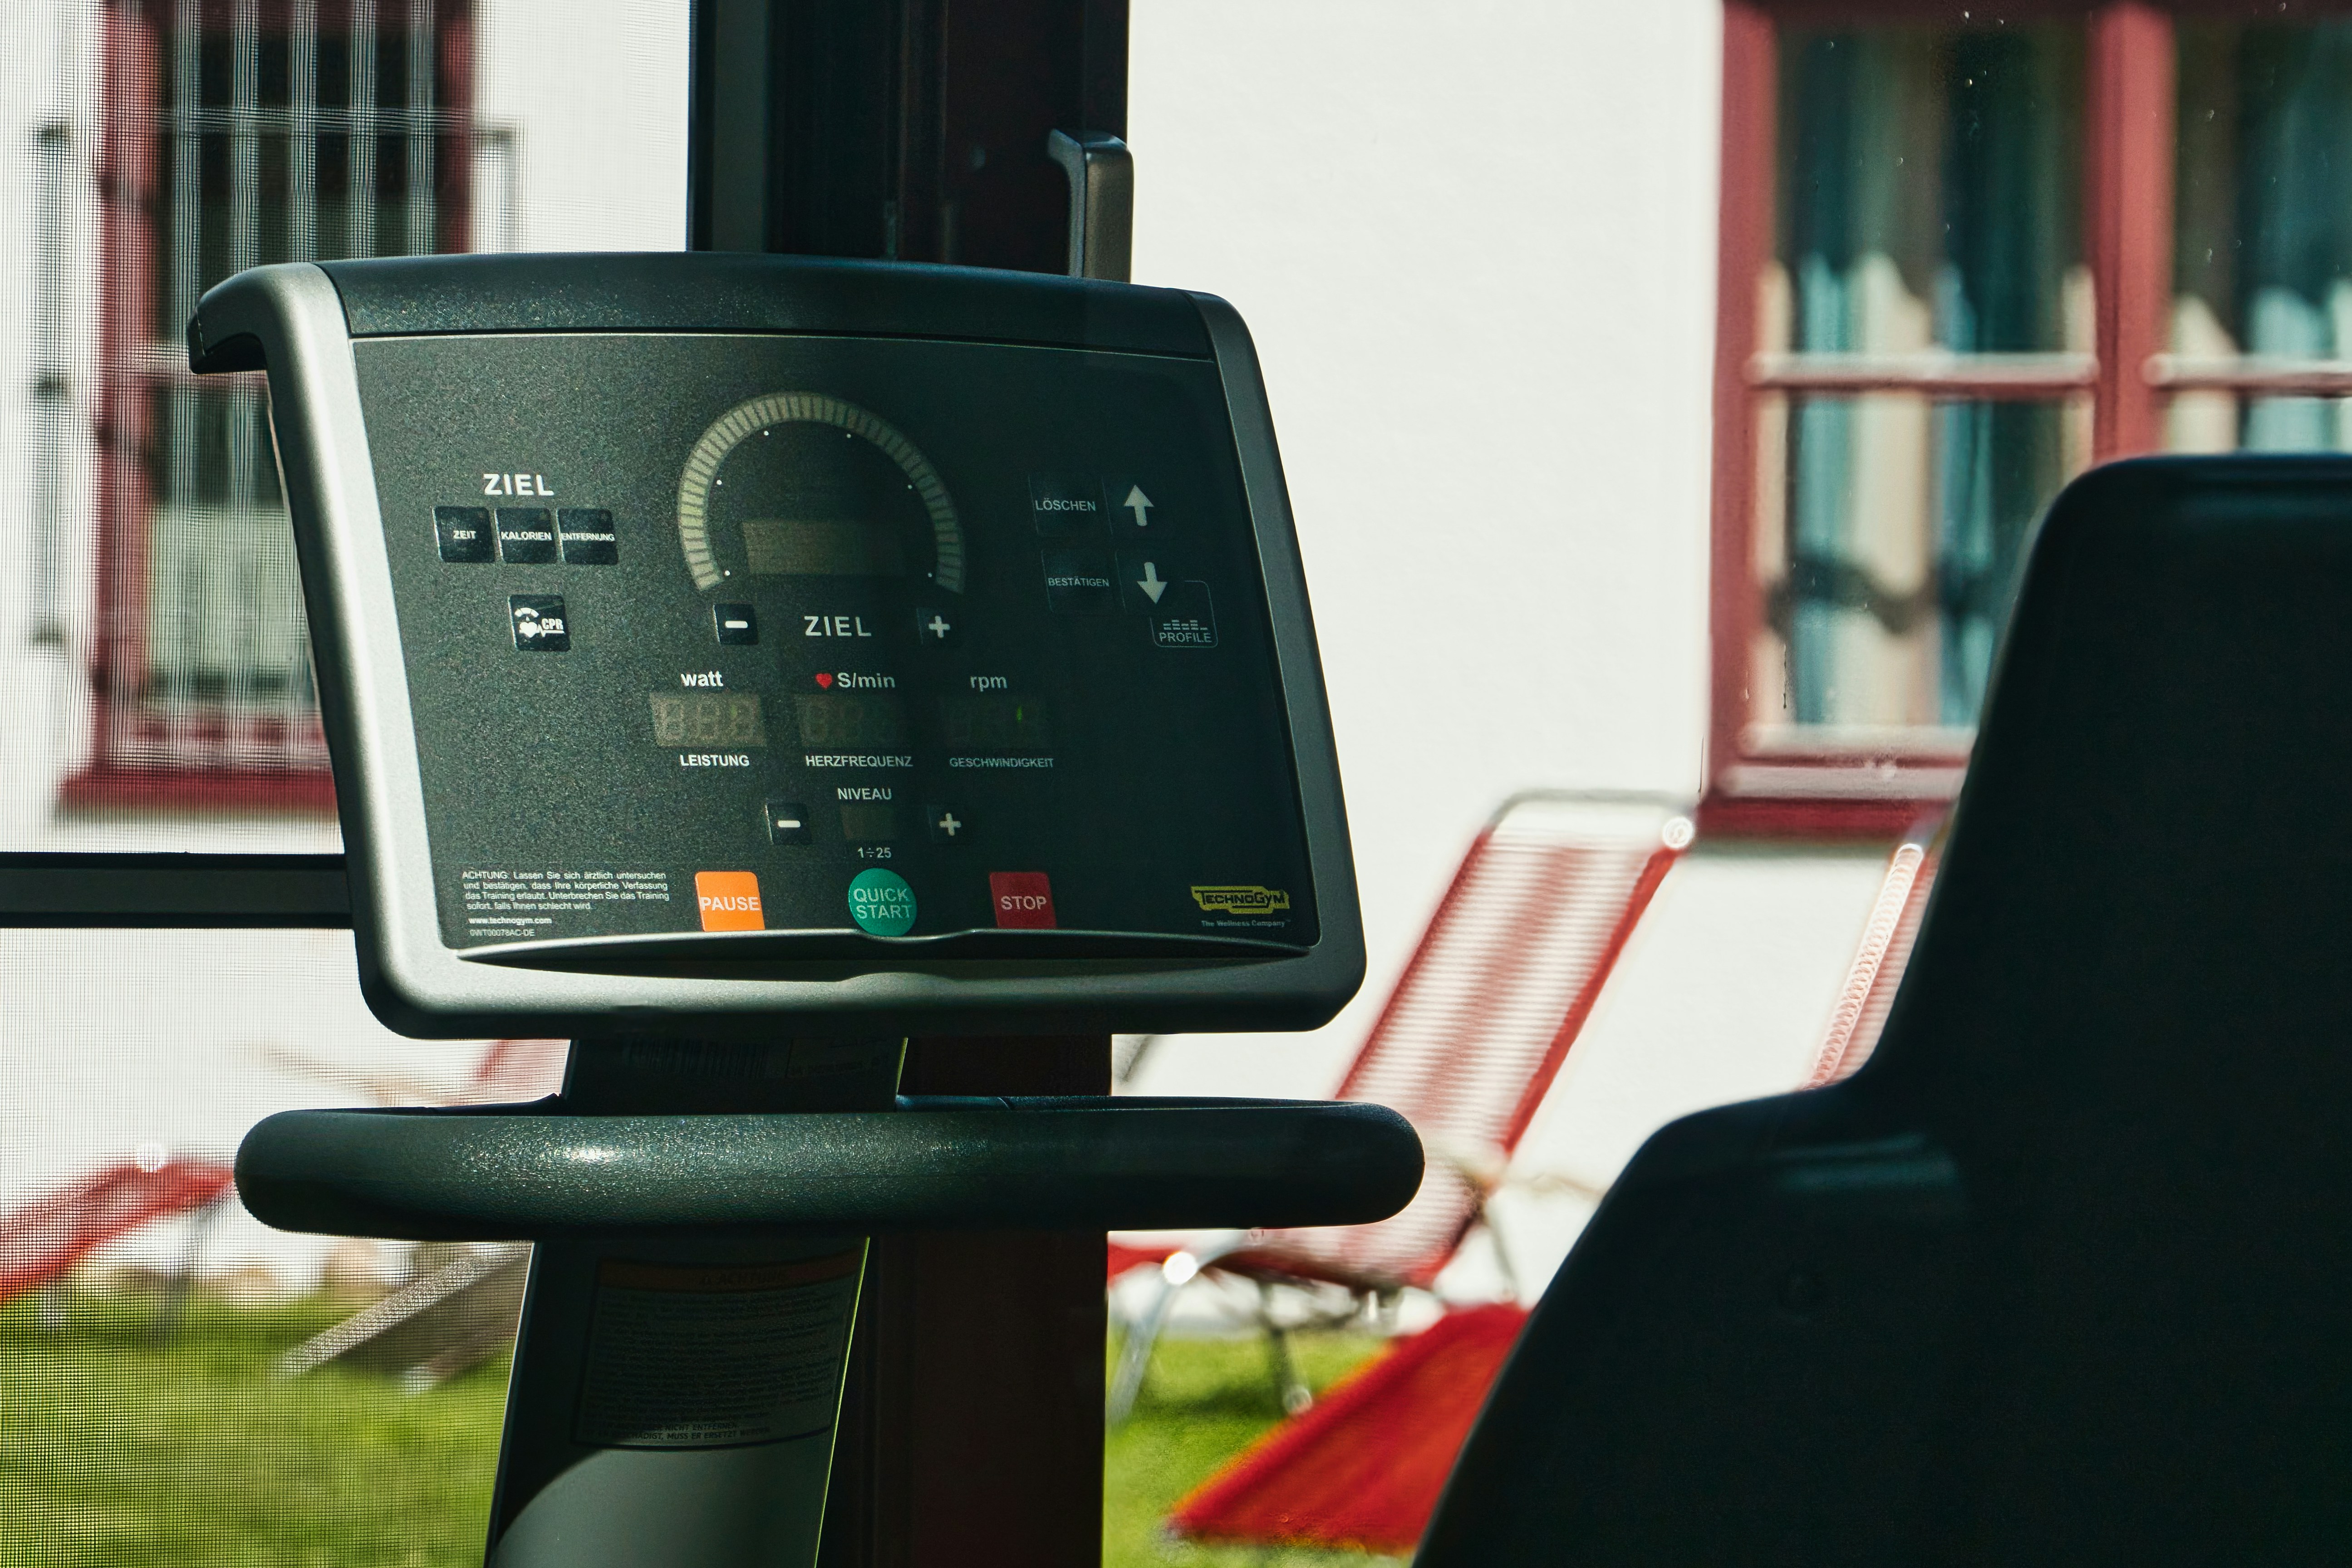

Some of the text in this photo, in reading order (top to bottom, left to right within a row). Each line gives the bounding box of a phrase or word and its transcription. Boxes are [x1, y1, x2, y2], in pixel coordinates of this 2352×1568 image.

[483, 473, 555, 496] ZIEL
[1035, 498, 1096, 511] LÖSCHEN
[453, 530, 476, 540] ZEIT
[501, 531, 552, 541] KALORIEN
[562, 532, 615, 542] ENTFERNUNG
[1048, 576, 1110, 587] BESTÄTIGEN
[541, 618, 564, 630] CPR
[804, 615, 872, 637] ZIEL
[1159, 632, 1213, 643] PROFILE
[681, 671, 724, 687] watt
[837, 672, 896, 689] S/min
[970, 675, 1008, 692] rpm
[680, 754, 750, 767] LEISTUNG
[805, 755, 913, 767] HERZFREQUENZ
[949, 757, 1054, 768] GESCHWINDIGKEIT
[837, 788, 893, 801] NIVEAU
[513, 871, 544, 880] Lassen
[546, 871, 561, 880] Sie
[564, 871, 580, 880] sich
[584, 871, 613, 880] ärztlich
[616, 871, 666, 880] untersuchen
[463, 881, 480, 890] und
[531, 881, 552, 890] dass
[555, 881, 571, 890] Ihre
[574, 881, 619, 891] körperliche
[622, 881, 668, 891] Verfassung
[465, 891, 670, 901] das Training erlaubt. Unterbrechen Sie das Training
[853, 888, 910, 903] QUICK
[494, 902, 512, 910] falls
[513, 902, 537, 910] Ihnen
[538, 902, 572, 910] schlecht
[700, 896, 760, 912] PAUSE
[1001, 895, 1047, 911] STOP
[856, 904, 912, 919] START
[468, 917, 552, 926] www.technogym.com
